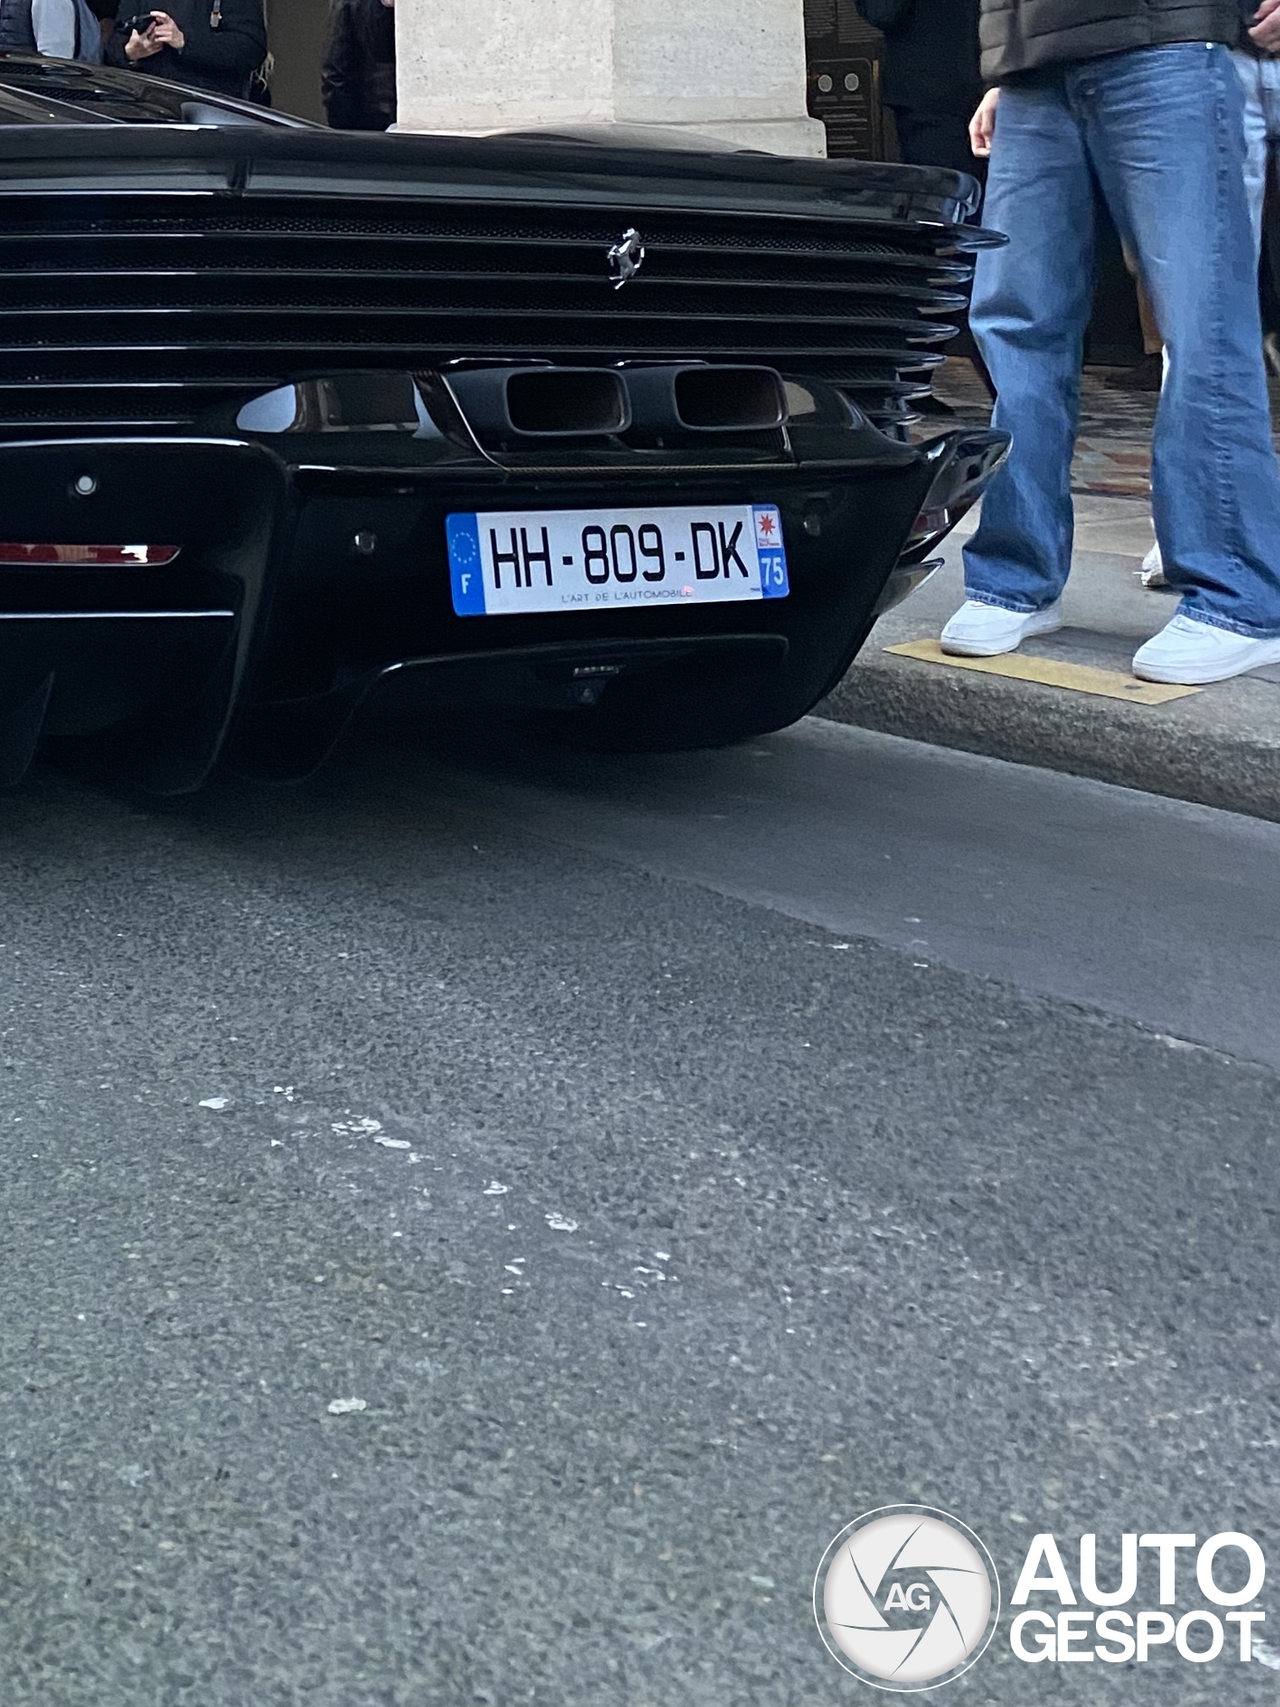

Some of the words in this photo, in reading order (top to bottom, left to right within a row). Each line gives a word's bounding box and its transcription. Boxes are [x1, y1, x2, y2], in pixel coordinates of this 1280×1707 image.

[489, 521, 749, 589] HH-809-DK
[761, 557, 784, 585] 75
[461, 574, 471, 594] F
[561, 593, 589, 604] L'ART
[595, 593, 609, 602] DE
